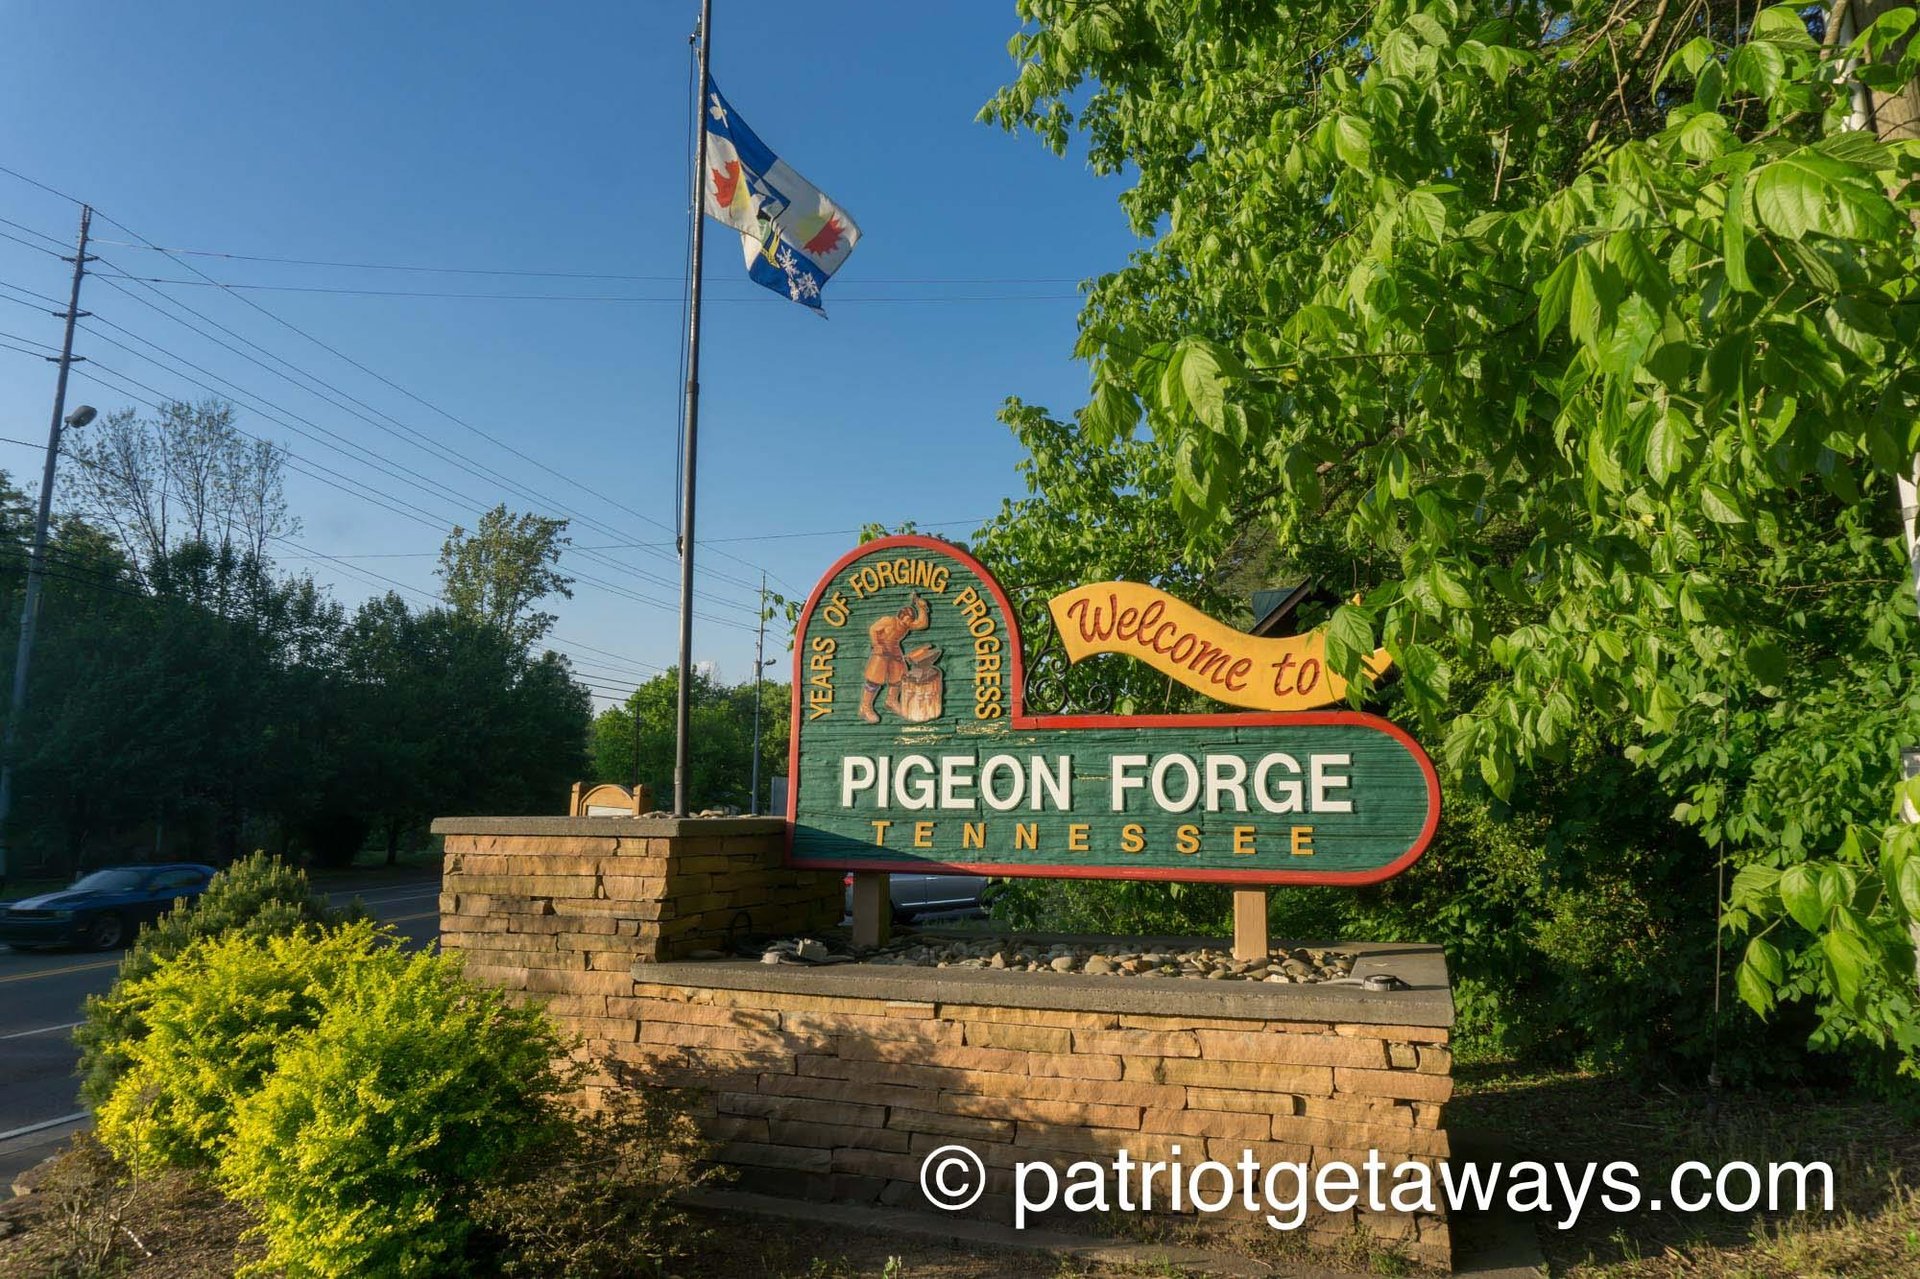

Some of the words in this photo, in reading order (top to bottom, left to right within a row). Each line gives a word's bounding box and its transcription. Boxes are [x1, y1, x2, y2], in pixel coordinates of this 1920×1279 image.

[823, 591, 851, 627] OF
[850, 559, 950, 599] FORGING
[953, 586, 1002, 720] PROGRESS
[1067, 594, 1253, 691] Welcome
[1272, 653, 1321, 696] to
[810, 637, 837, 720] YEARS
[841, 754, 1072, 812] PIGEON
[1112, 752, 1354, 814] FORGE
[871, 820, 1316, 856] TENNESSEE
